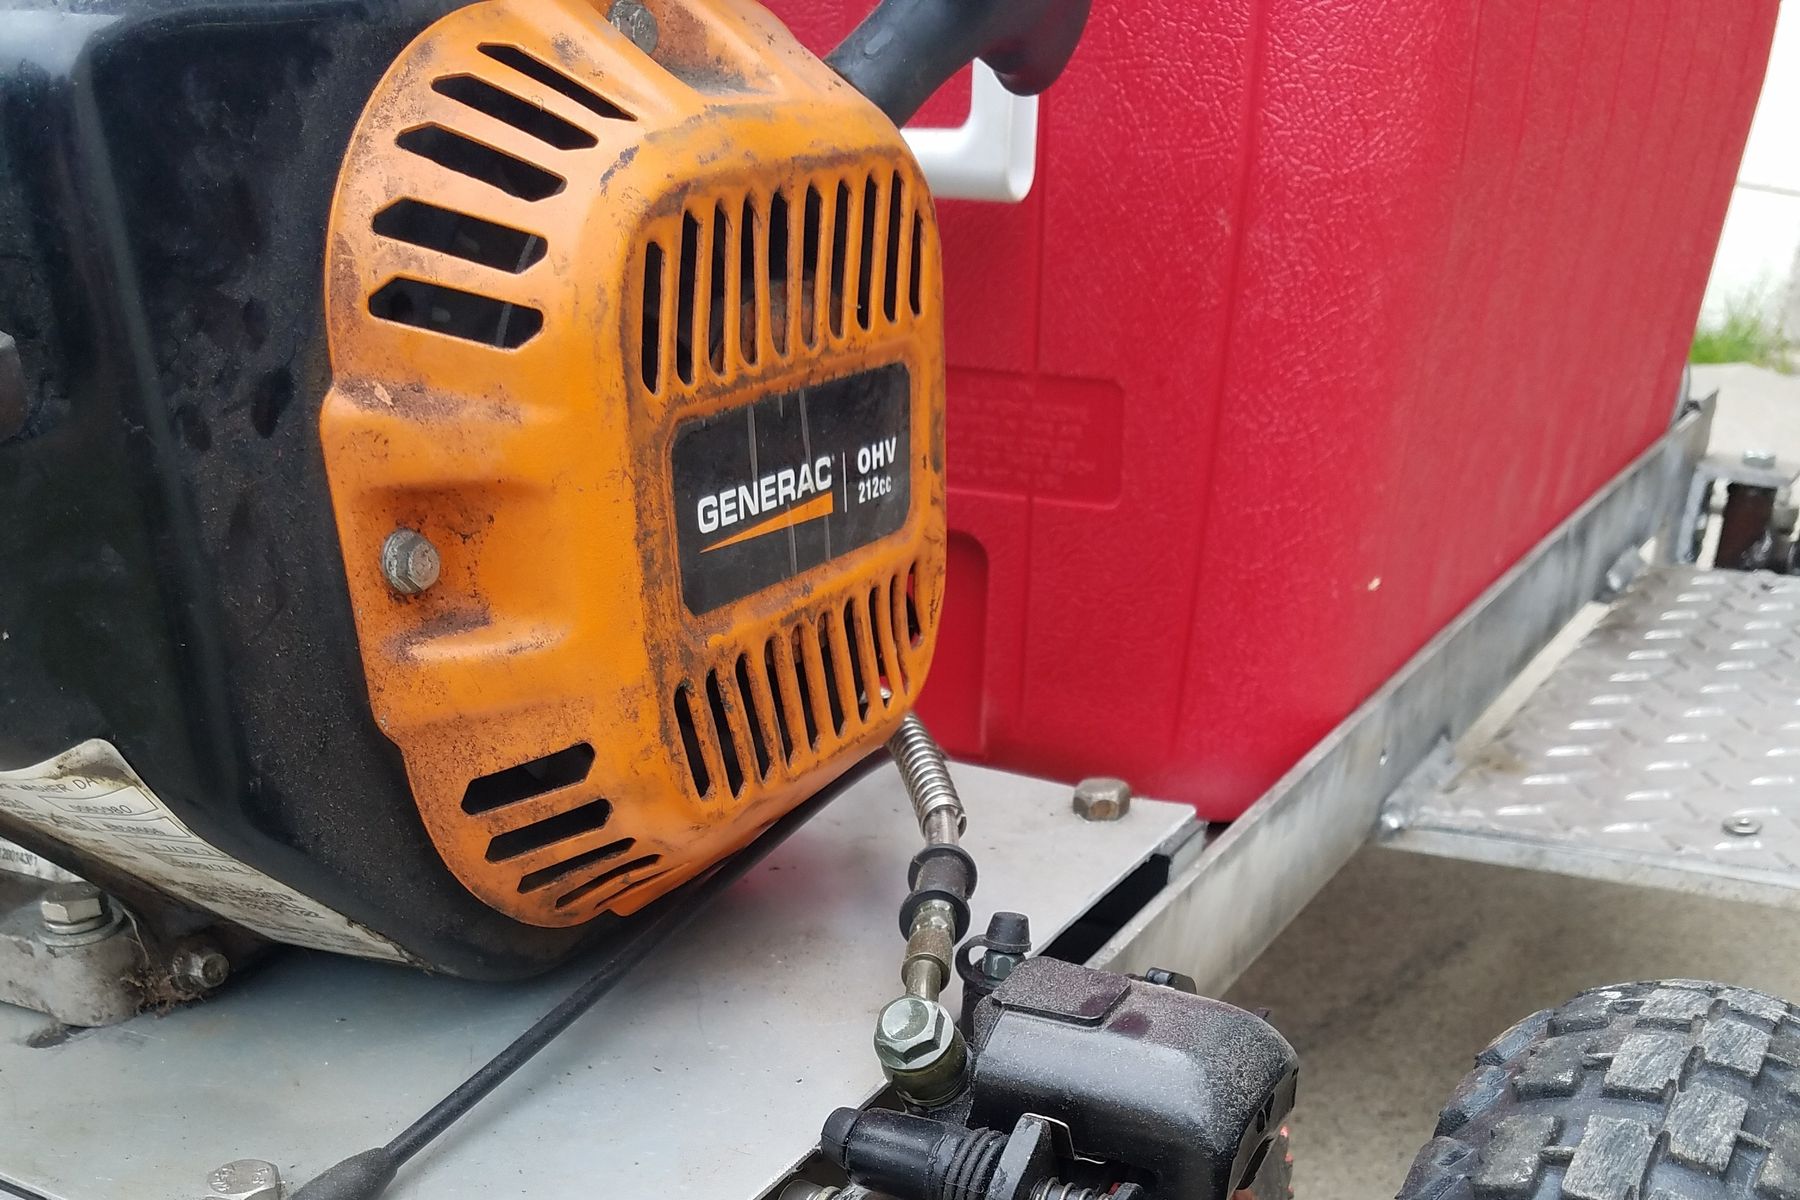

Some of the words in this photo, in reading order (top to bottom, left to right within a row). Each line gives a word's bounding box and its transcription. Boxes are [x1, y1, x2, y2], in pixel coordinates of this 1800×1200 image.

[857, 436, 897, 475] OHV
[697, 456, 833, 534] GENERAC
[857, 476, 892, 504] 212cc
